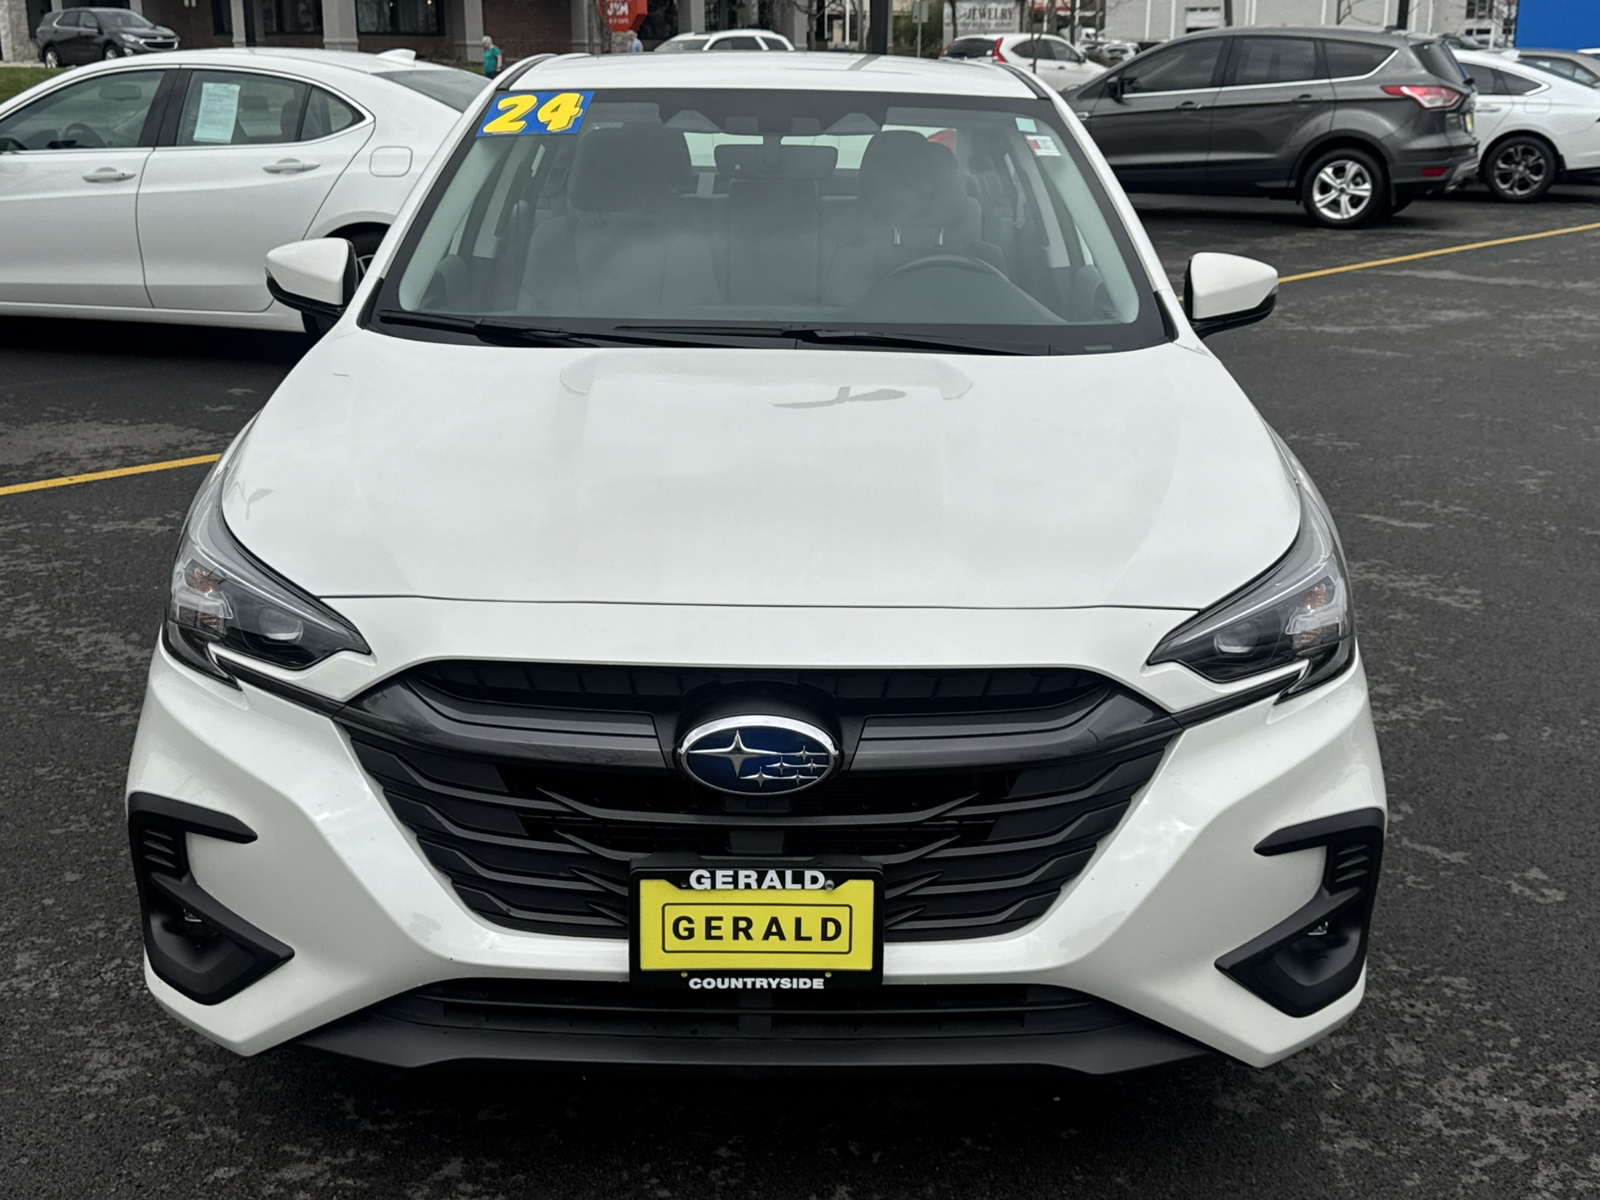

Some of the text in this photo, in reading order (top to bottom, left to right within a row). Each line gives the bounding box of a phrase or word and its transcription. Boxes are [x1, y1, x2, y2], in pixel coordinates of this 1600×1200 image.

[967, 7, 1013, 20] JEWELRY
[482, 92, 584, 134] 24
[689, 869, 825, 890] GERALD
[672, 916, 842, 941] GERALD
[688, 977, 825, 989] COUNTRYSIDE
